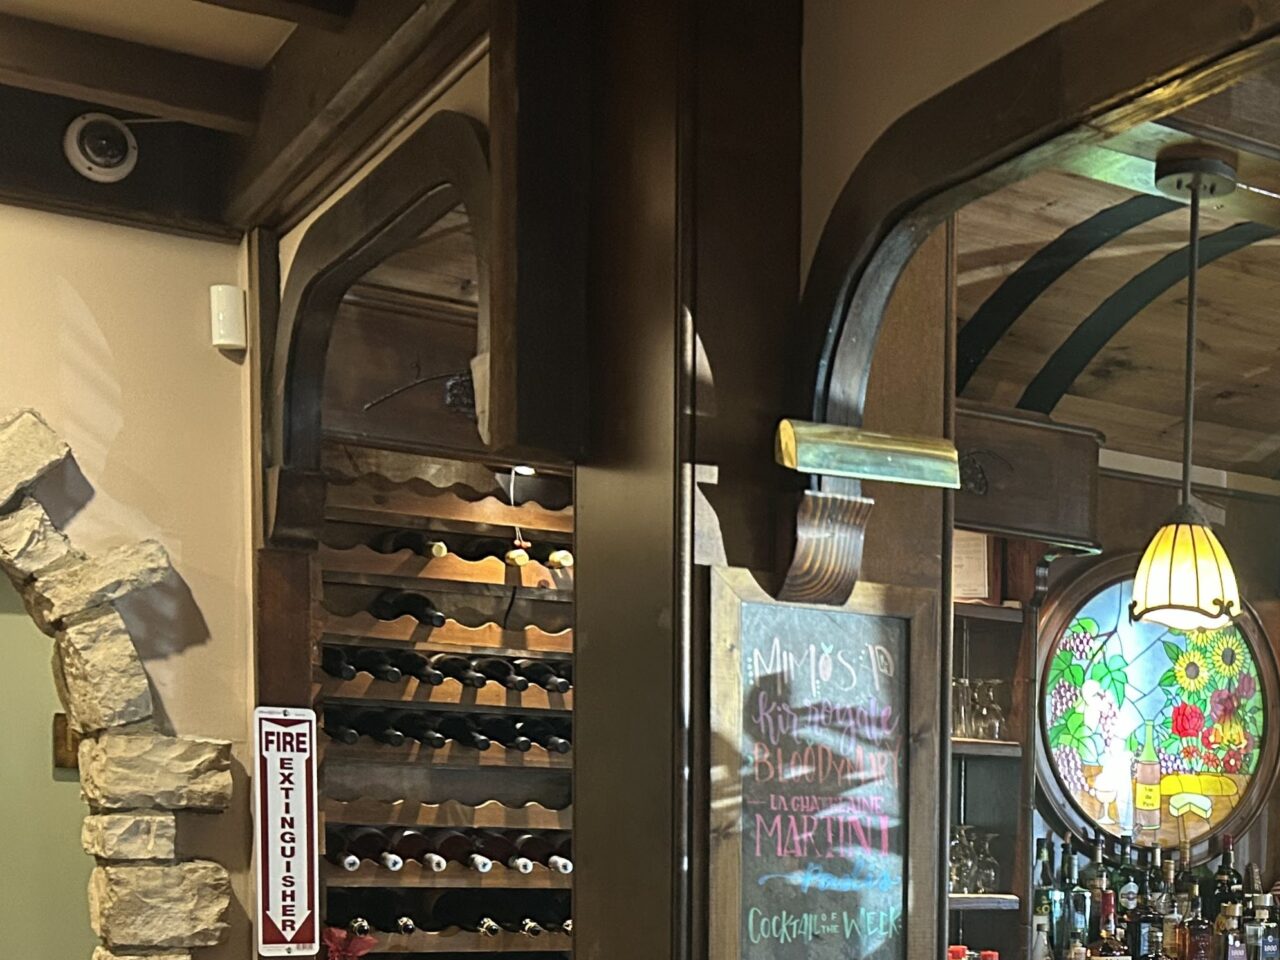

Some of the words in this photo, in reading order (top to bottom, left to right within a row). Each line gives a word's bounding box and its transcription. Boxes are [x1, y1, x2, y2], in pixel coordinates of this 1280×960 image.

[264, 730, 308, 753] FIRE
[753, 742, 845, 786] BLOODY
[846, 738, 899, 790] MARY
[770, 794, 788, 811] LA
[279, 757, 296, 932] EXTINGUISHER
[755, 813, 889, 858] MARTINI
[821, 912, 838, 922] OF
[821, 925, 839, 933] THE
